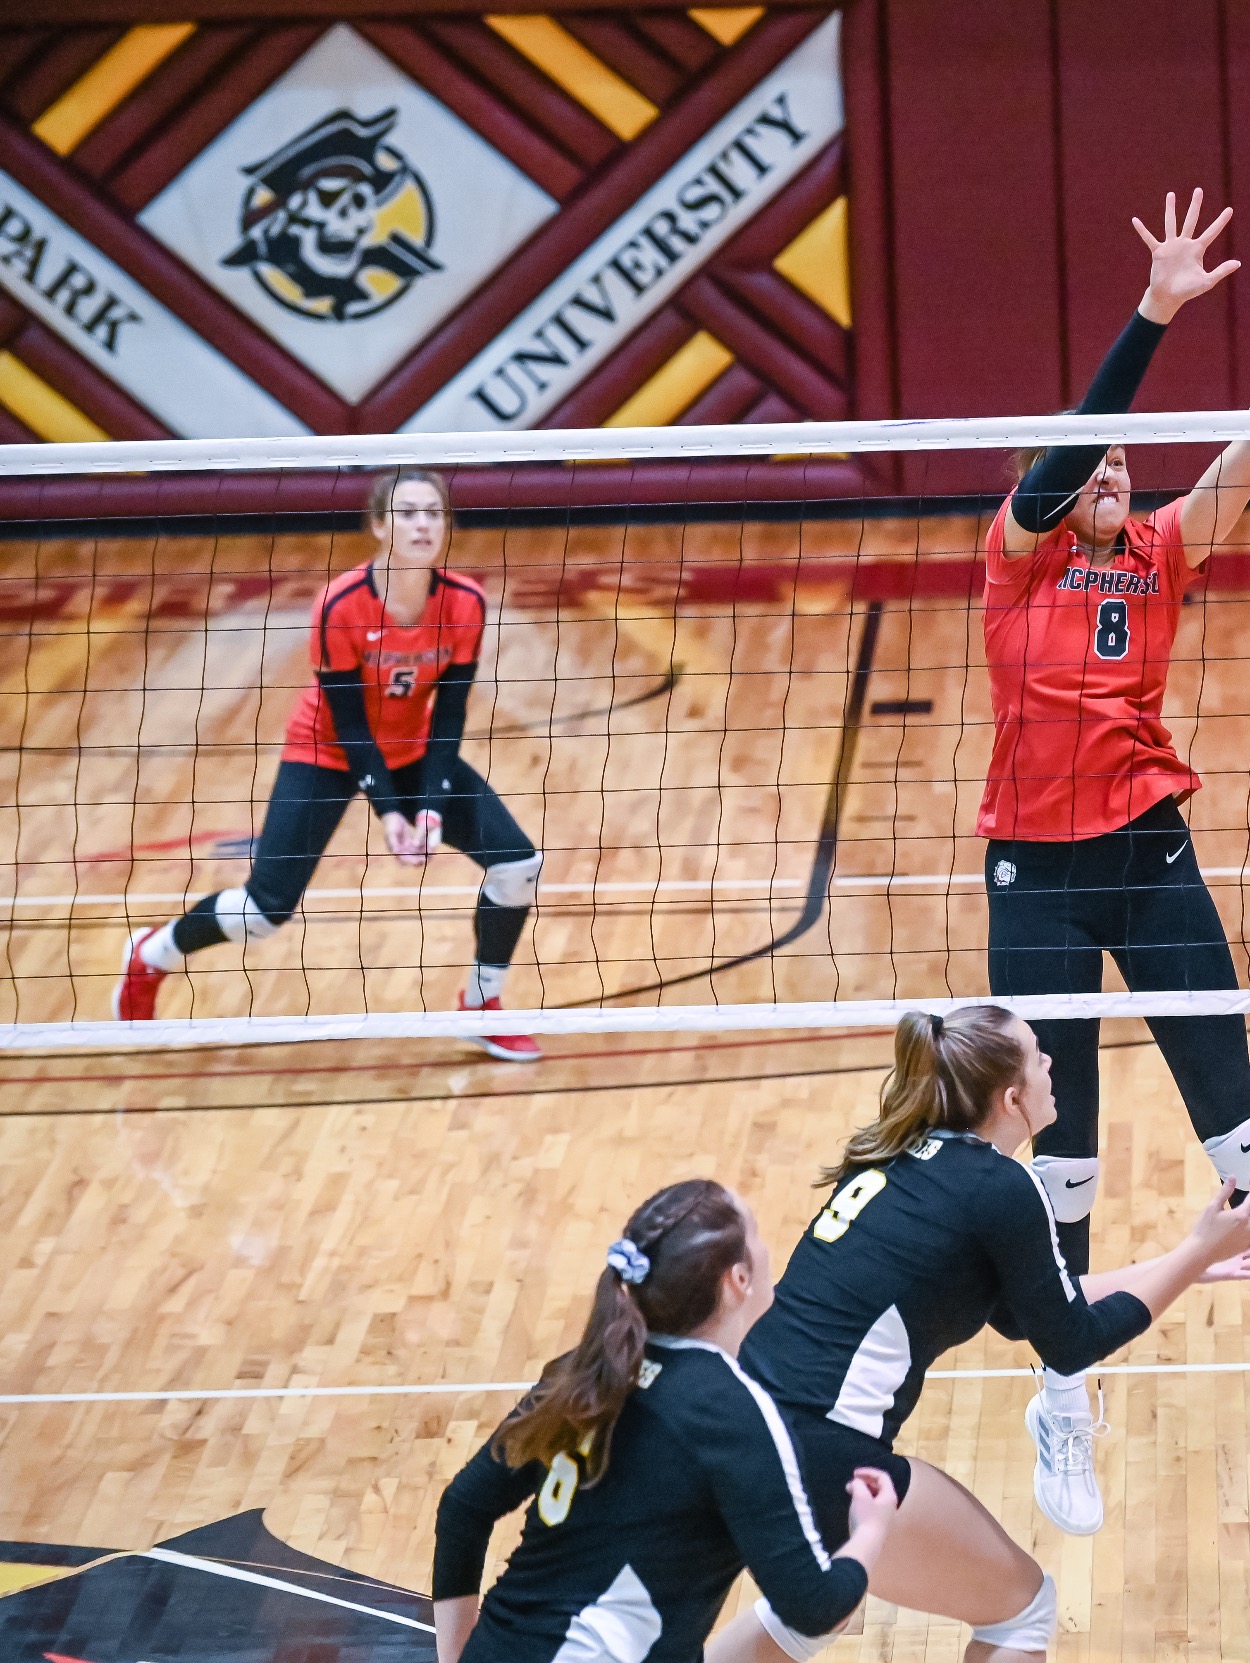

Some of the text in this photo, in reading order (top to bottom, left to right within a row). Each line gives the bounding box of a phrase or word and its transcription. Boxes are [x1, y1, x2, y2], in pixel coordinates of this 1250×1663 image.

[0, 205, 143, 359] PARK
[467, 92, 808, 423] UNIVERSITY
[1094, 598, 1130, 660] 8
[384, 666, 419, 698] 5
[813, 1168, 887, 1243] 9
